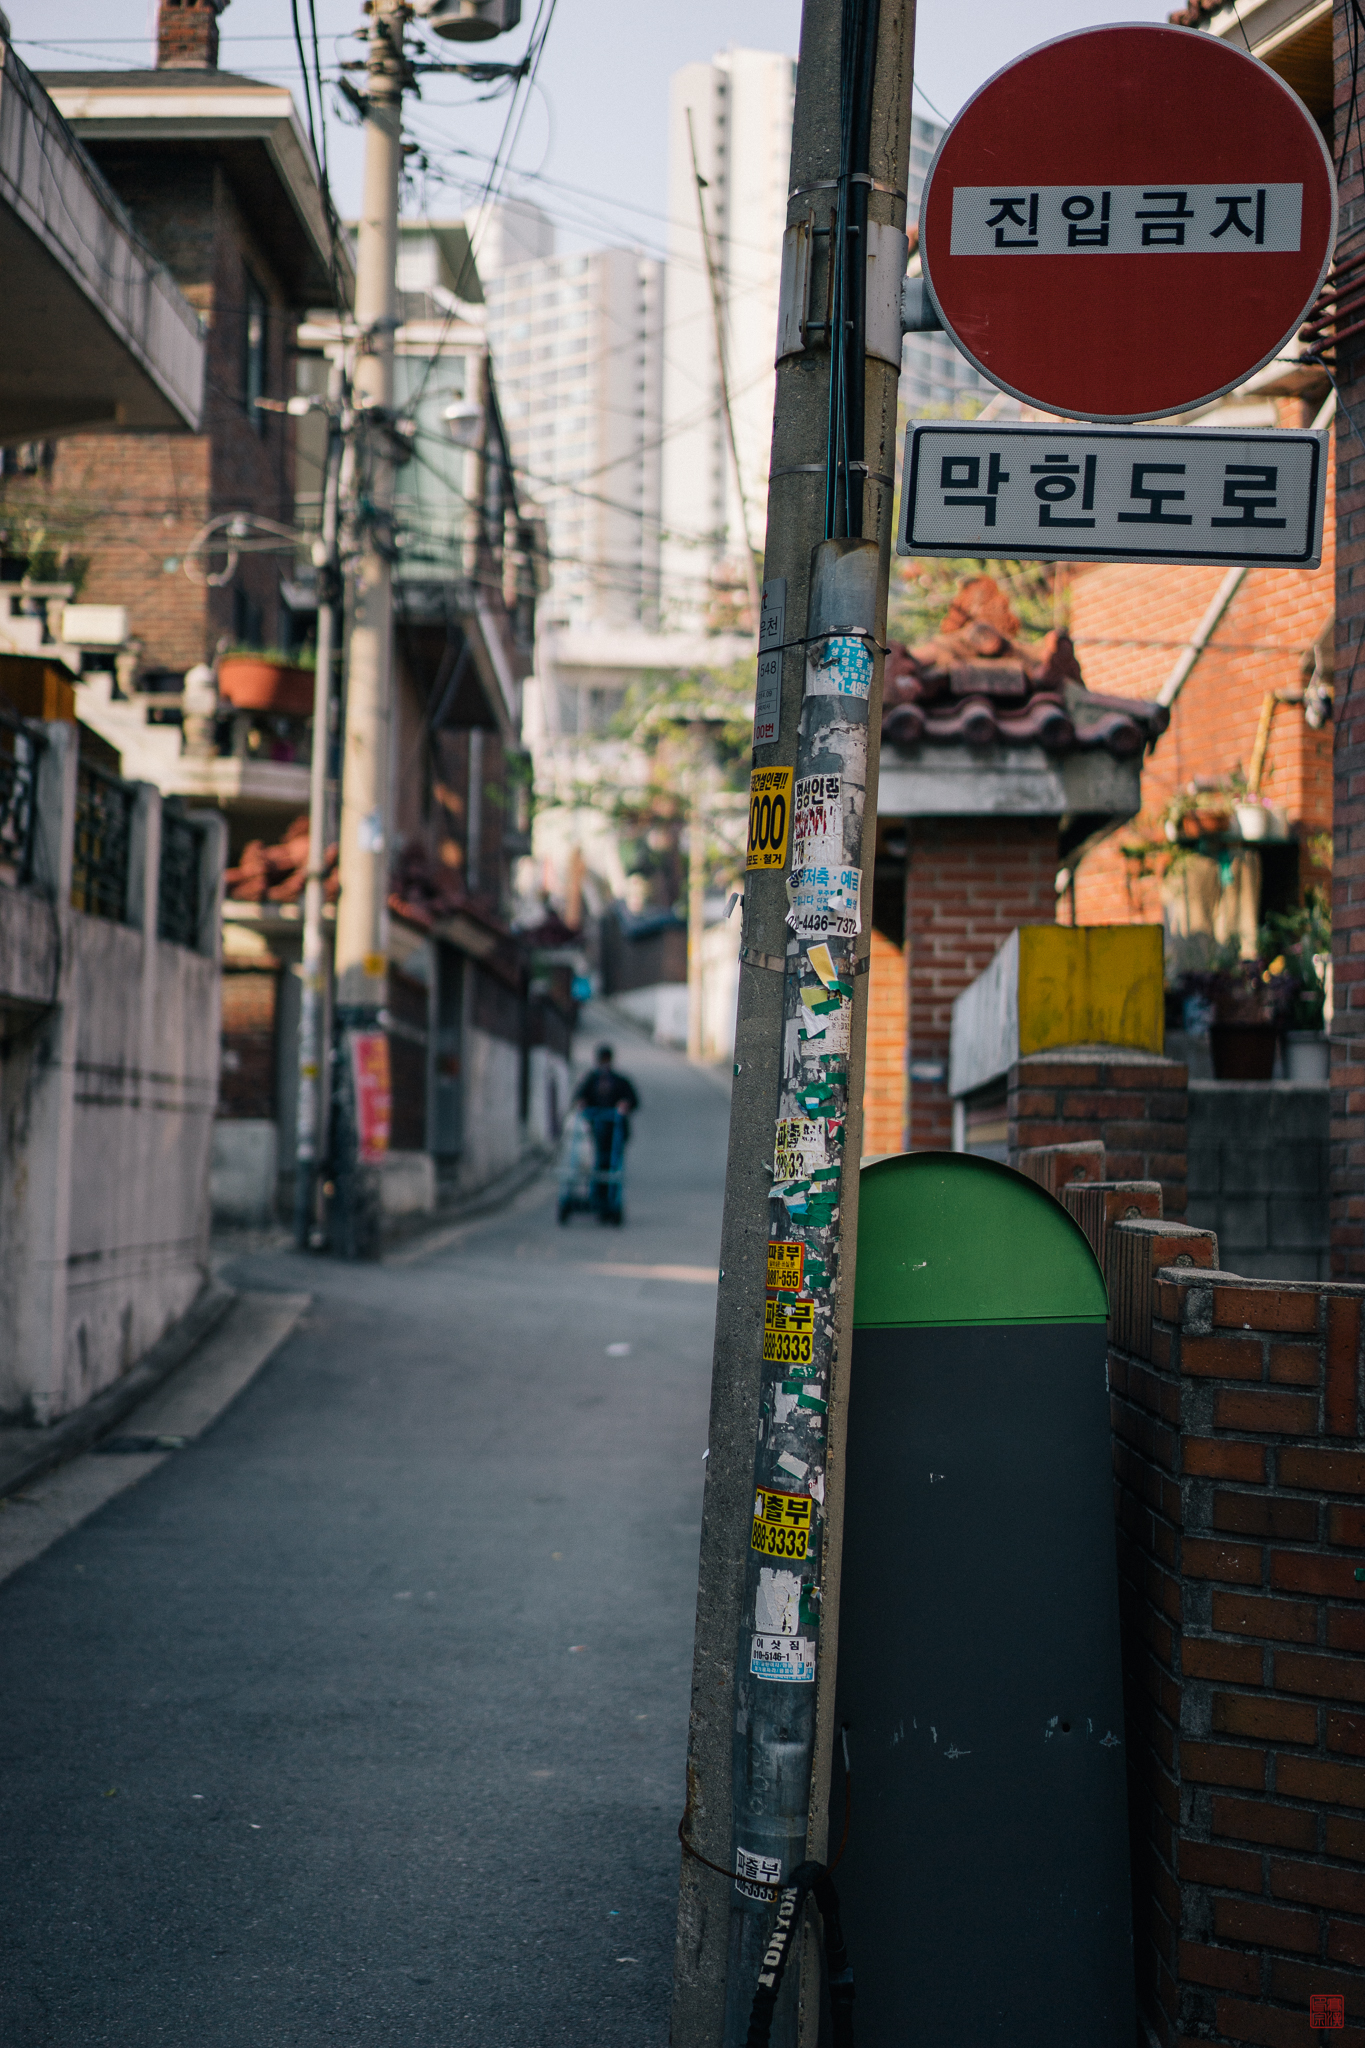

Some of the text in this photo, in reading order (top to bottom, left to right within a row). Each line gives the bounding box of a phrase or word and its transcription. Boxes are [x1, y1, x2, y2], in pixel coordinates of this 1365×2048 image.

[985, 189, 1267, 248] 진입금지
[939, 452, 1287, 529] 막힌도로
[768, 1245, 800, 1261] 파출부
[752, 1521, 807, 1558] 888-3333
